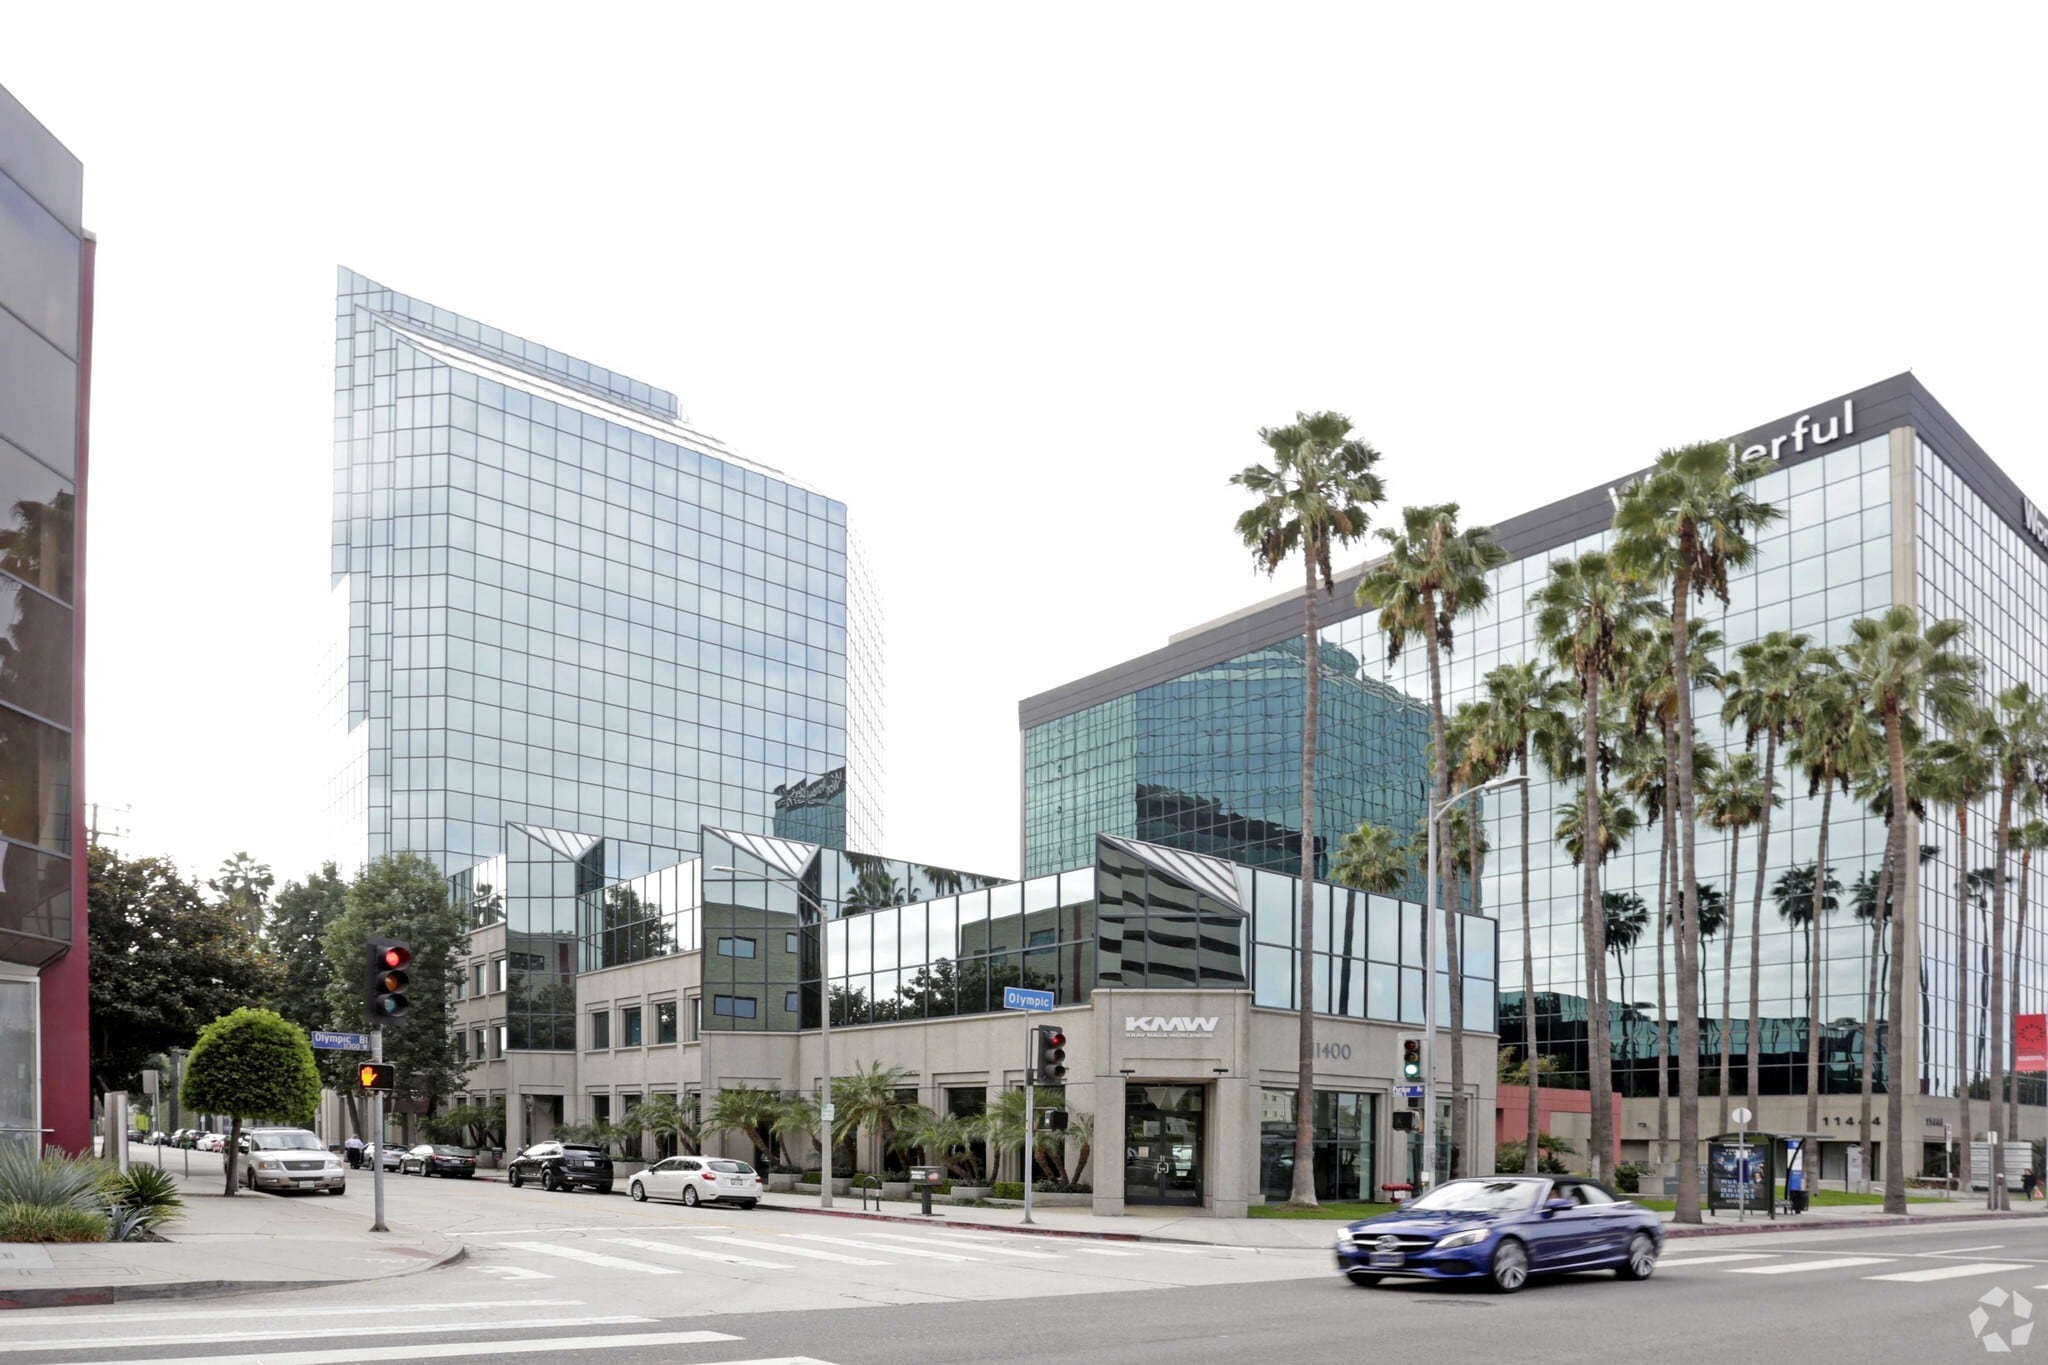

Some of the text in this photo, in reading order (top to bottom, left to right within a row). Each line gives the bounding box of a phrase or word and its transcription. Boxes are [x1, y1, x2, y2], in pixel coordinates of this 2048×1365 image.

[1608, 399, 1854, 513] erful
[1008, 993, 1050, 1008] Olympic
[1125, 1016, 1219, 1032] KMW
[314, 1032, 351, 1045] Olympic
[1311, 1042, 1352, 1060] 1400
[1822, 1116, 1881, 1126] 1144
